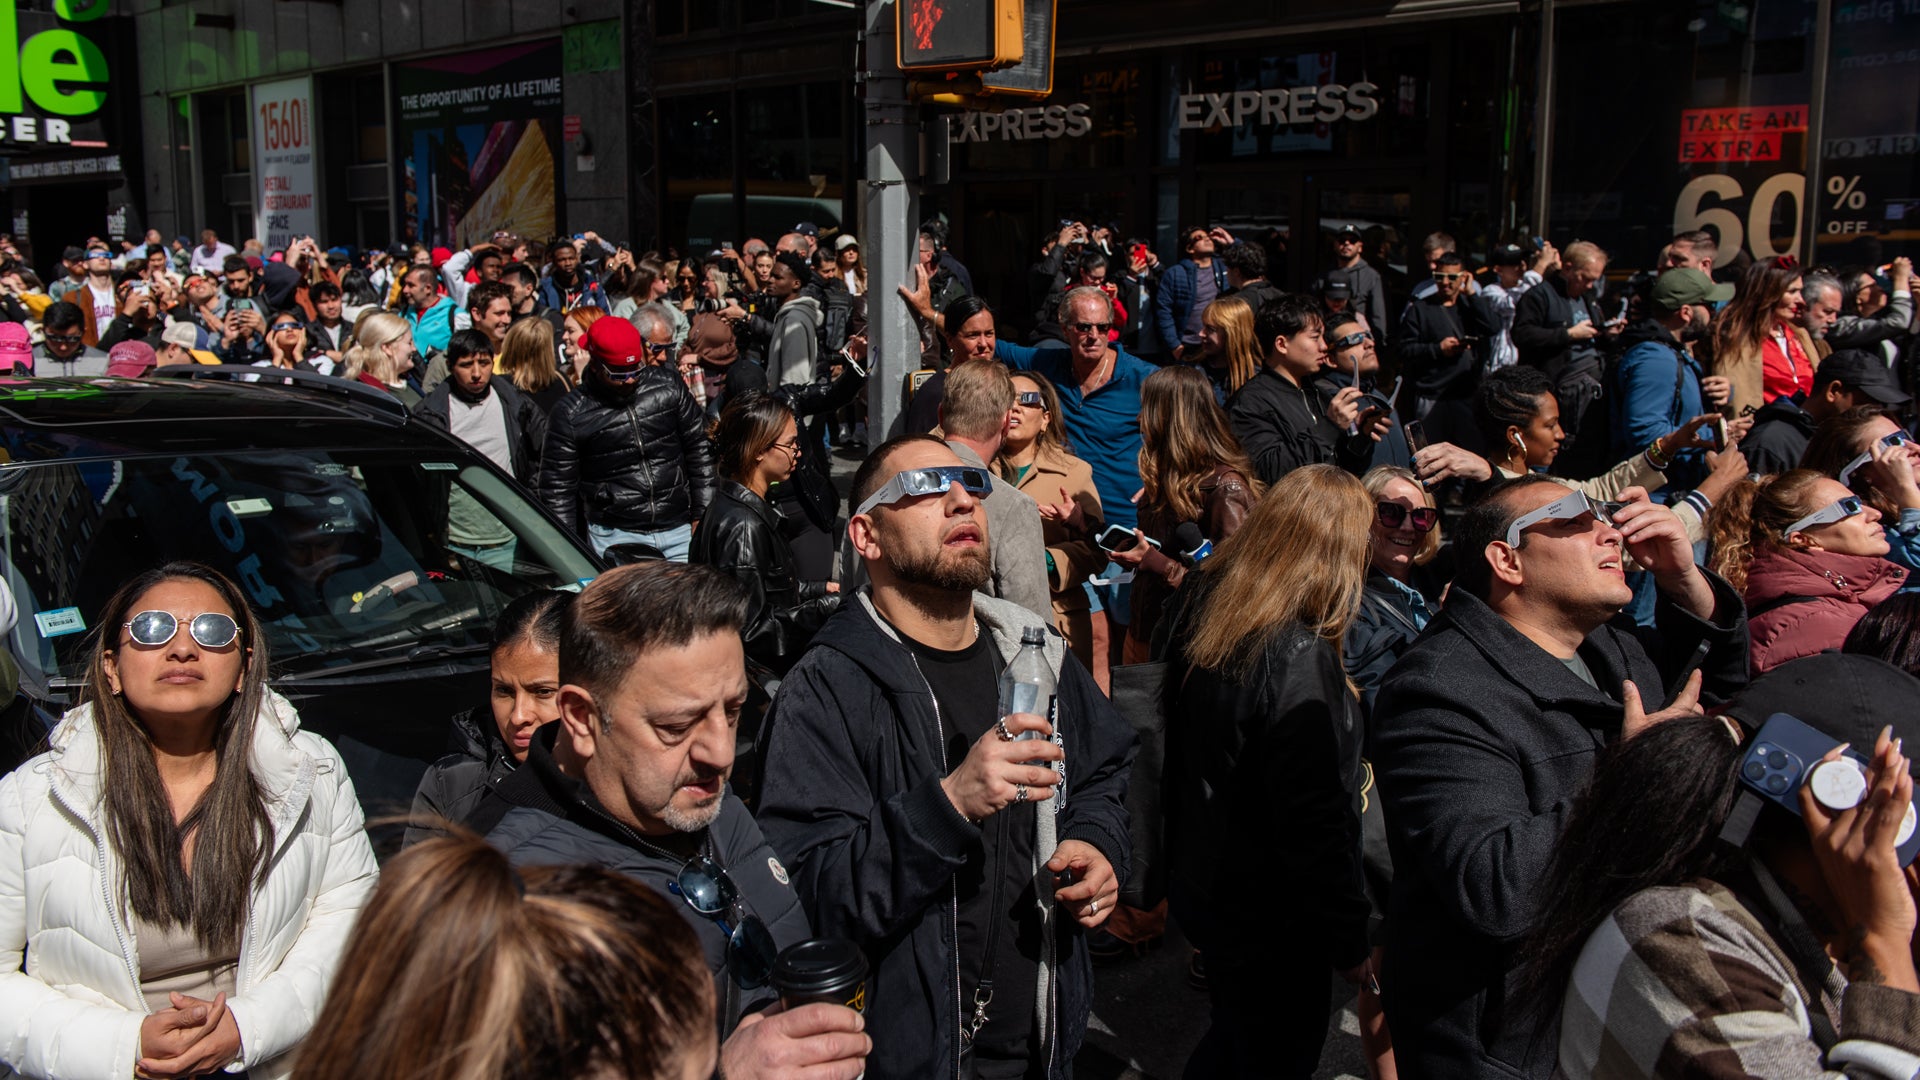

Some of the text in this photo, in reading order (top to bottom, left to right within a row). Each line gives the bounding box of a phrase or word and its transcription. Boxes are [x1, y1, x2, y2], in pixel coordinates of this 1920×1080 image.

[401, 77, 561, 110] THE OPPORTUNITY OF A LIFETIME
[1179, 81, 1379, 129] EXPRESS
[260, 98, 302, 150] 1560
[938, 103, 1093, 143] EXPRESS
[1684, 110, 1801, 132] TAKE AN
[1682, 139, 1773, 160] EXTRA
[265, 194, 313, 211] RESTAURANT
[266, 215, 289, 231] SPACE
[1673, 172, 1867, 270] 60 %
[1827, 221, 1868, 235] OFF
